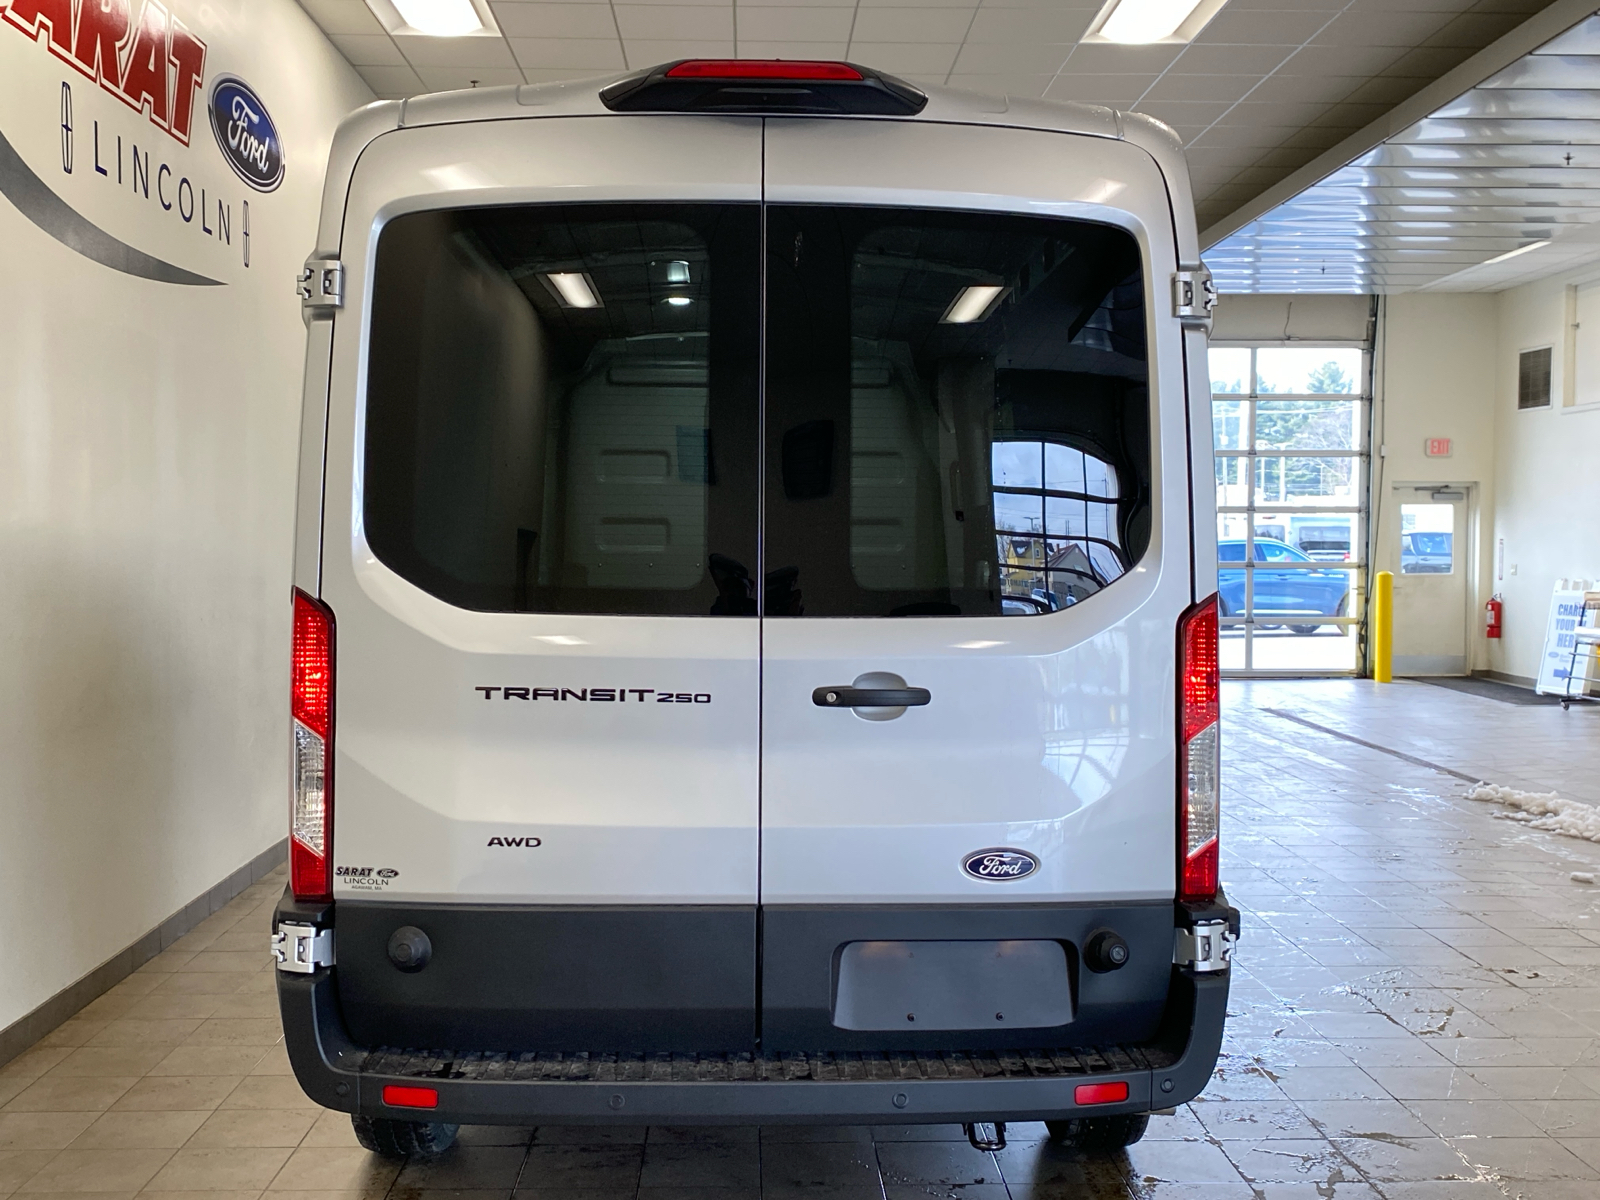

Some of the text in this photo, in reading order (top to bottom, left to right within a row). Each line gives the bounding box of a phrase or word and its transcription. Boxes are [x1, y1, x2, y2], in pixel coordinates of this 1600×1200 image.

[0, 0, 207, 148] RAT
[227, 95, 270, 173] Ford
[93, 120, 231, 246] LINCOLN
[1430, 438, 1451, 454] EXIT
[1555, 618, 1576, 632] YOUR
[1556, 633, 1576, 649] HER
[475, 686, 712, 704] TRANSIT 250
[487, 837, 542, 848] AWD
[335, 866, 374, 877] SARAT
[979, 856, 1022, 875] Ford
[343, 877, 389, 886] LINCOLN
